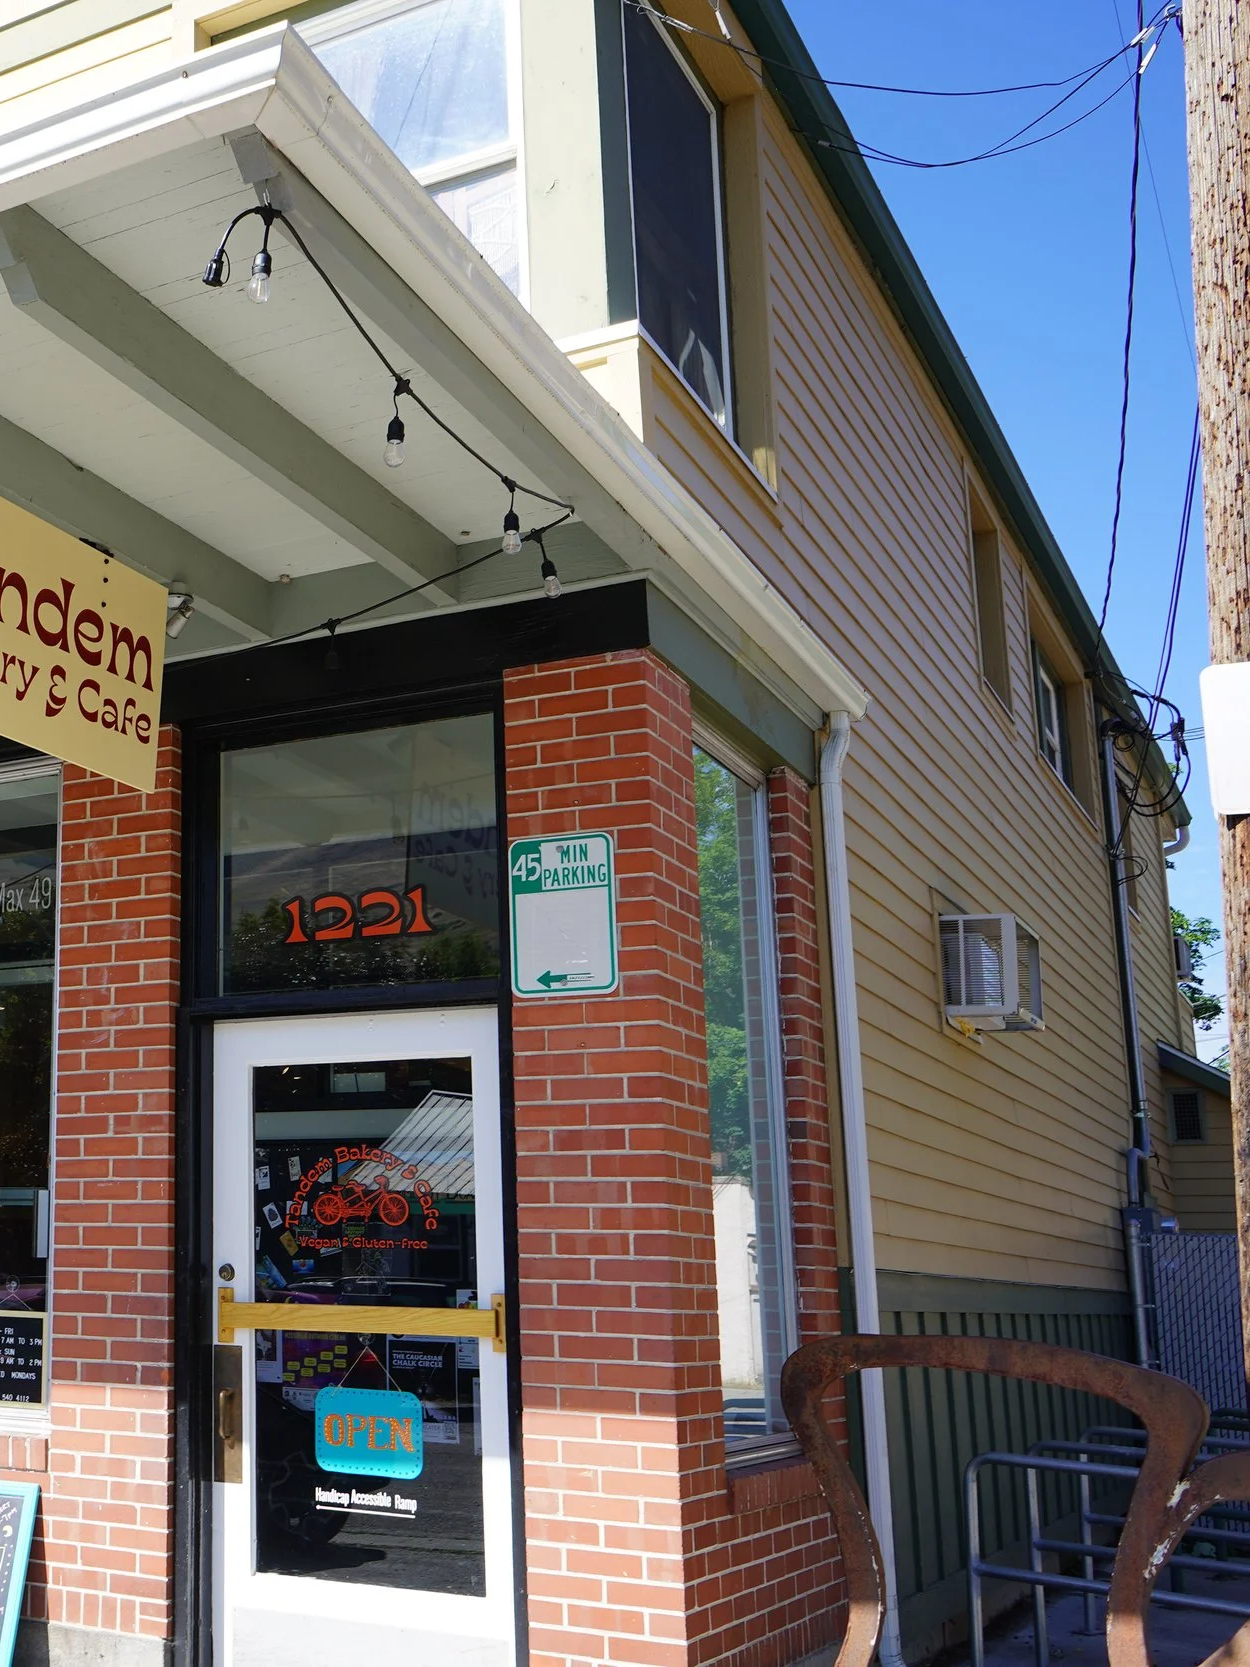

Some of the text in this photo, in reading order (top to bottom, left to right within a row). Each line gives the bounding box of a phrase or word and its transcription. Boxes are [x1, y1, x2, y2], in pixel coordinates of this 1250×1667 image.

[45, 664, 67, 717] &
[78, 679, 151, 744] Cafe
[512, 843, 588, 882] 45 MIN
[543, 864, 606, 887] PARKING
[28, 877, 51, 909] 49
[283, 885, 435, 945] 1221
[285, 1158, 333, 1228] Tandem
[334, 1145, 402, 1171] Bakery
[413, 1179, 440, 1231] Cafe
[299, 1236, 339, 1249] Vegan
[352, 1236, 428, 1249] Gluten-free
[11, 1371, 36, 1380] MONDAYS
[418, 1360, 443, 1368] CIRCLE
[324, 1413, 414, 1453] OPEN
[315, 1487, 417, 1514] Handicap Accessible Ramp
